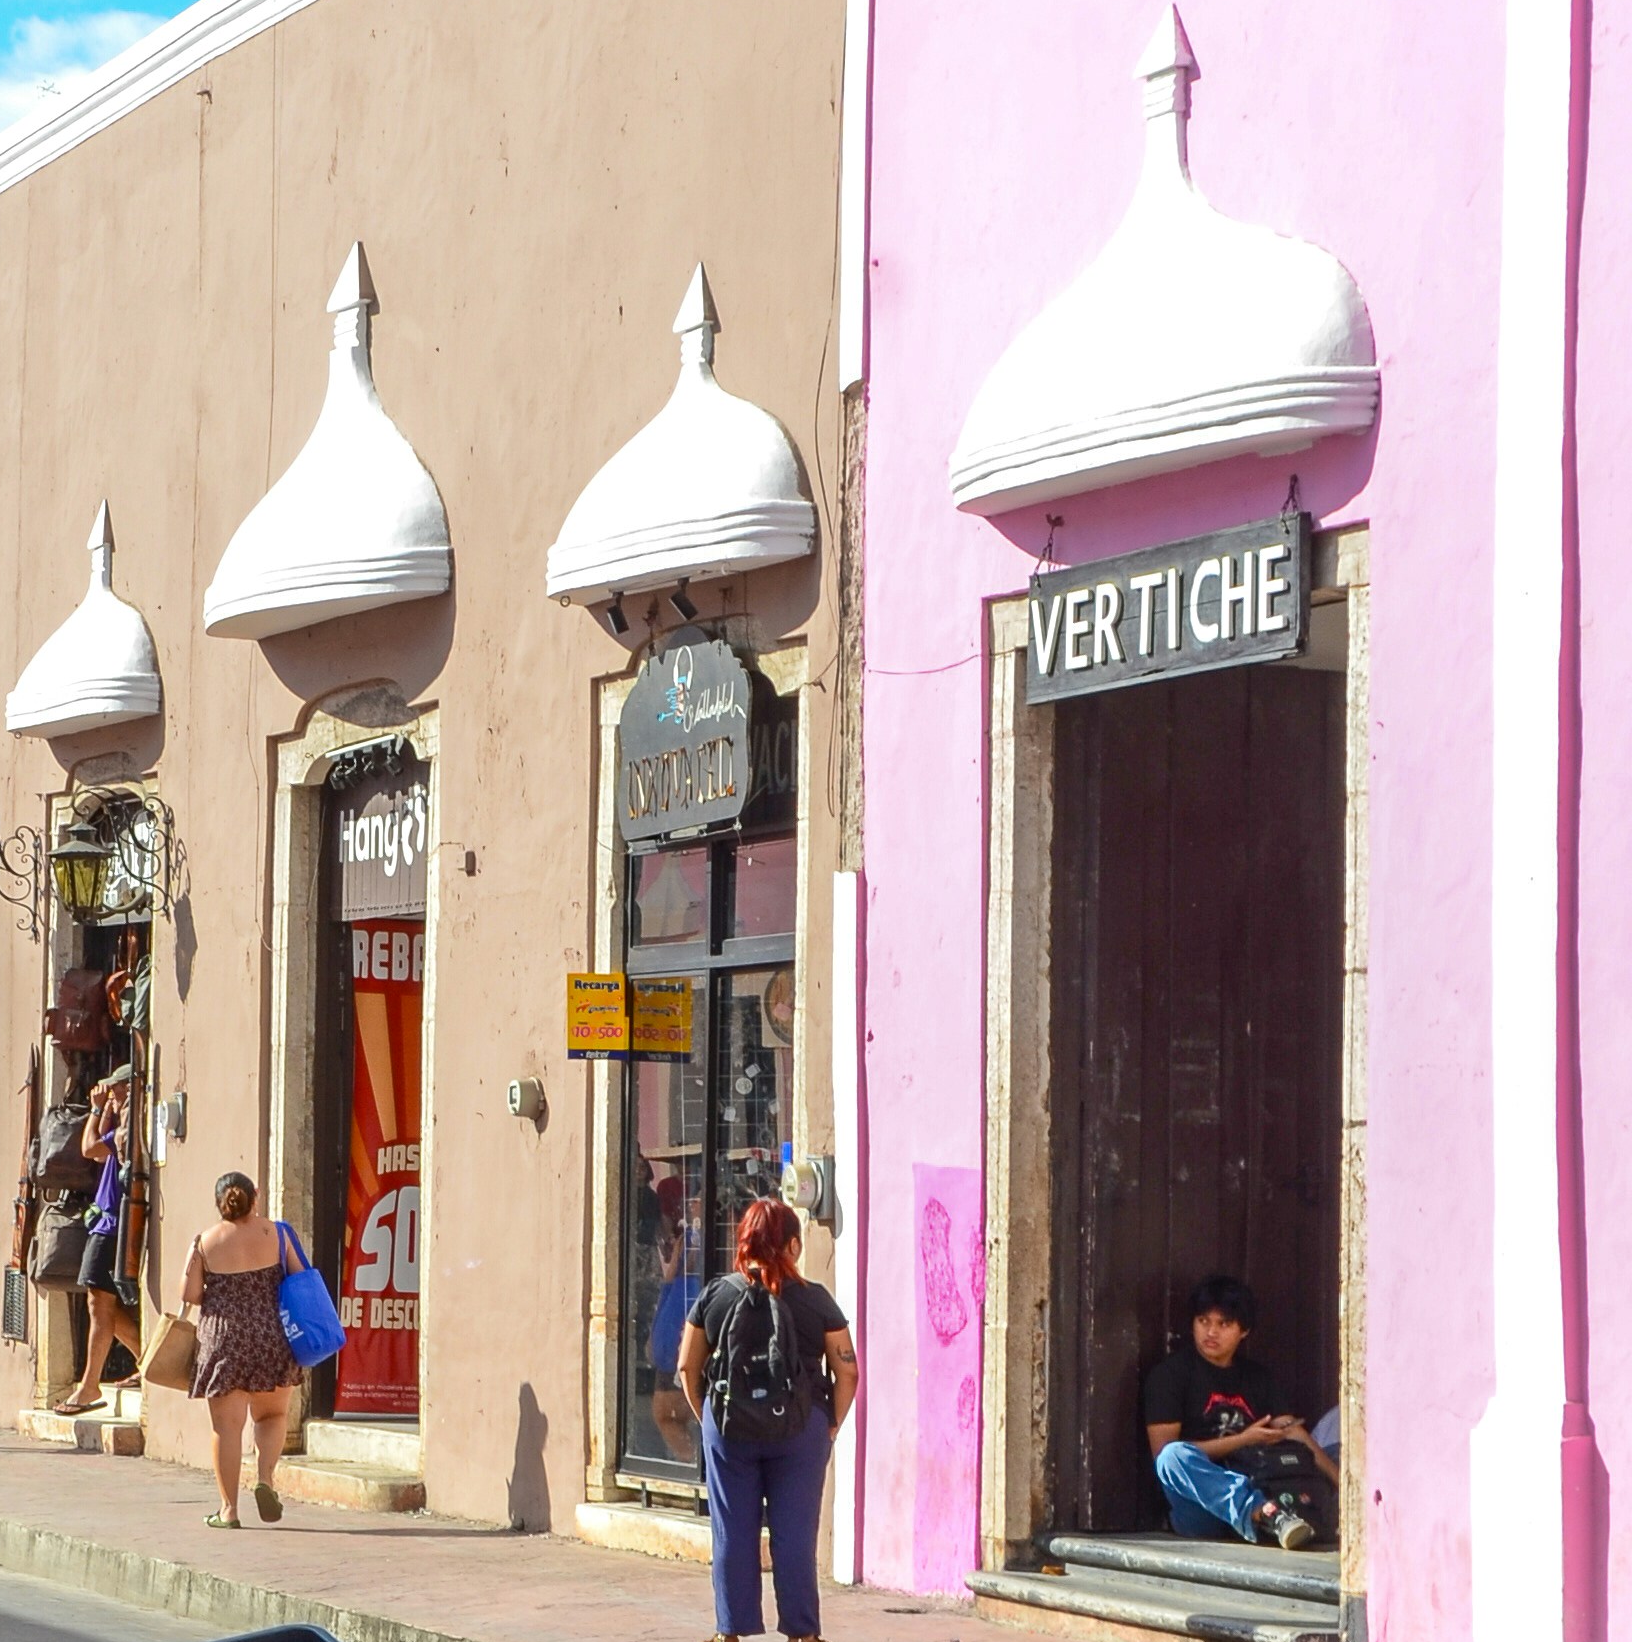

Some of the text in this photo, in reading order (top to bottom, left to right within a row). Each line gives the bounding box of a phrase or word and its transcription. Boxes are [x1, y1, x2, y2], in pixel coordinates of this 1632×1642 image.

[1030, 543, 1287, 676] VERTICHE
[339, 809, 399, 877] Hang
[574, 979, 620, 992] Recarga
[377, 1143, 420, 1176] HAS
[354, 1185, 420, 1293] 50
[340, 1296, 364, 1329] DE
